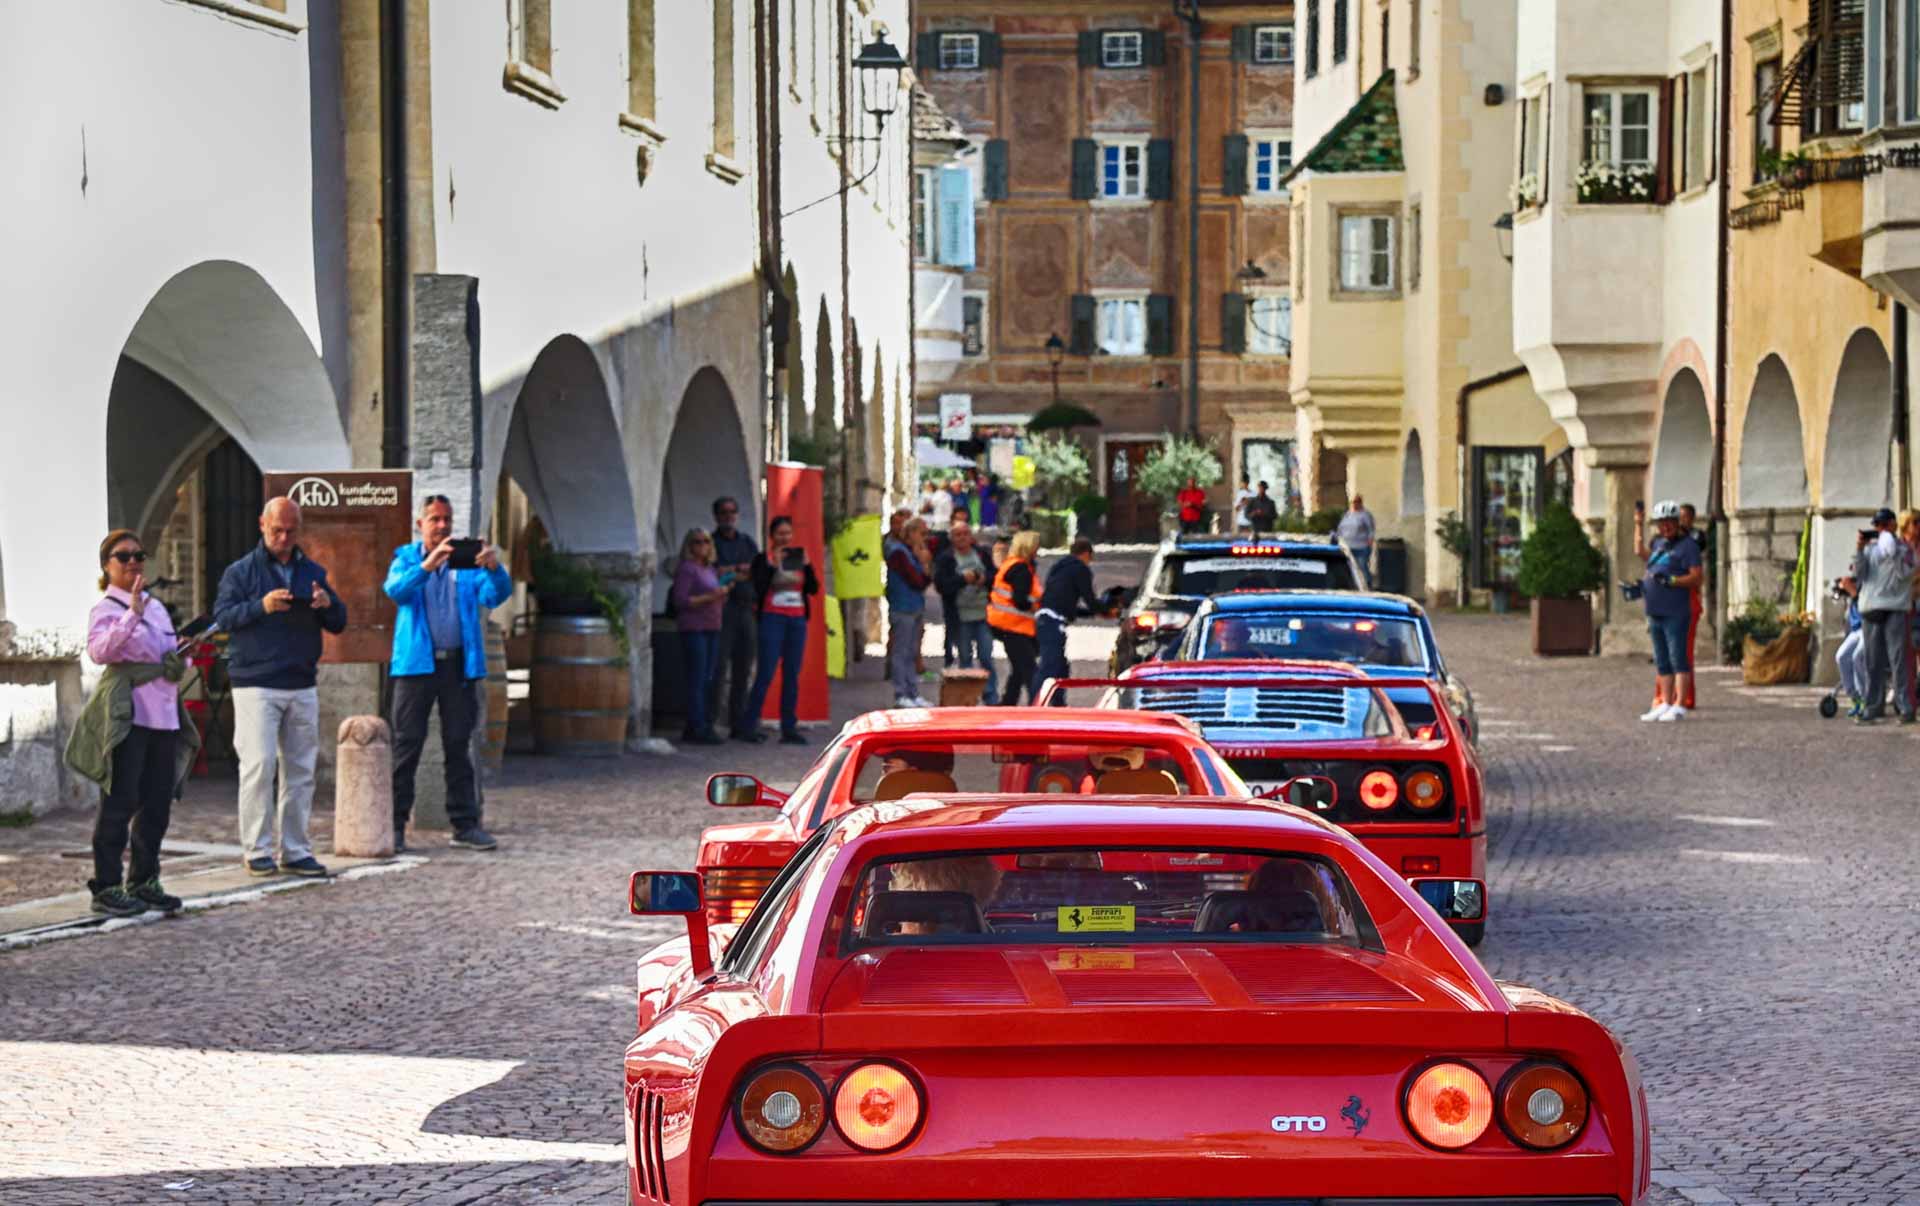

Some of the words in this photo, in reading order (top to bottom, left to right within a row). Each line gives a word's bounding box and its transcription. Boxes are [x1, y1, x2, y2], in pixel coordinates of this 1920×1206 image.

[300, 483, 330, 506] kfu
[339, 482, 398, 496] kunstforum
[346, 495, 398, 506] unterland
[1091, 907, 1122, 915] Ferrari
[1271, 1116, 1326, 1131] GTO
